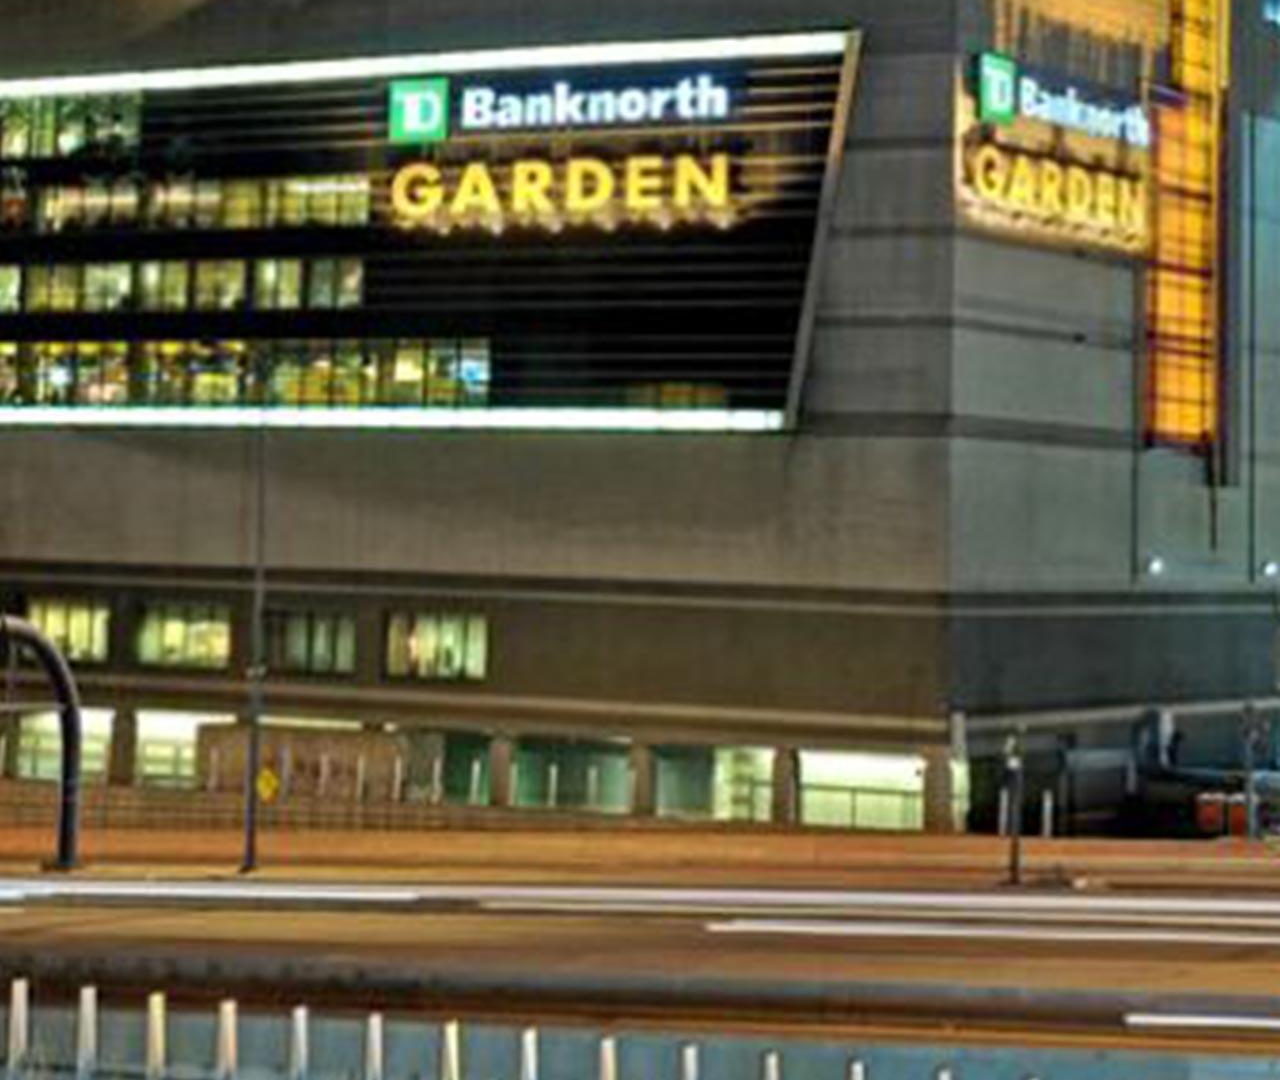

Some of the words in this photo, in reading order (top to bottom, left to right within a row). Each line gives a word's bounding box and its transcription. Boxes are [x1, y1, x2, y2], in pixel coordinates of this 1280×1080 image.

[392, 82, 444, 136] TD
[461, 74, 728, 127] Banknorth
[1021, 77, 1149, 146] Banknorth
[391, 154, 730, 216] GARDEN
[975, 146, 1147, 227] GARDEN
